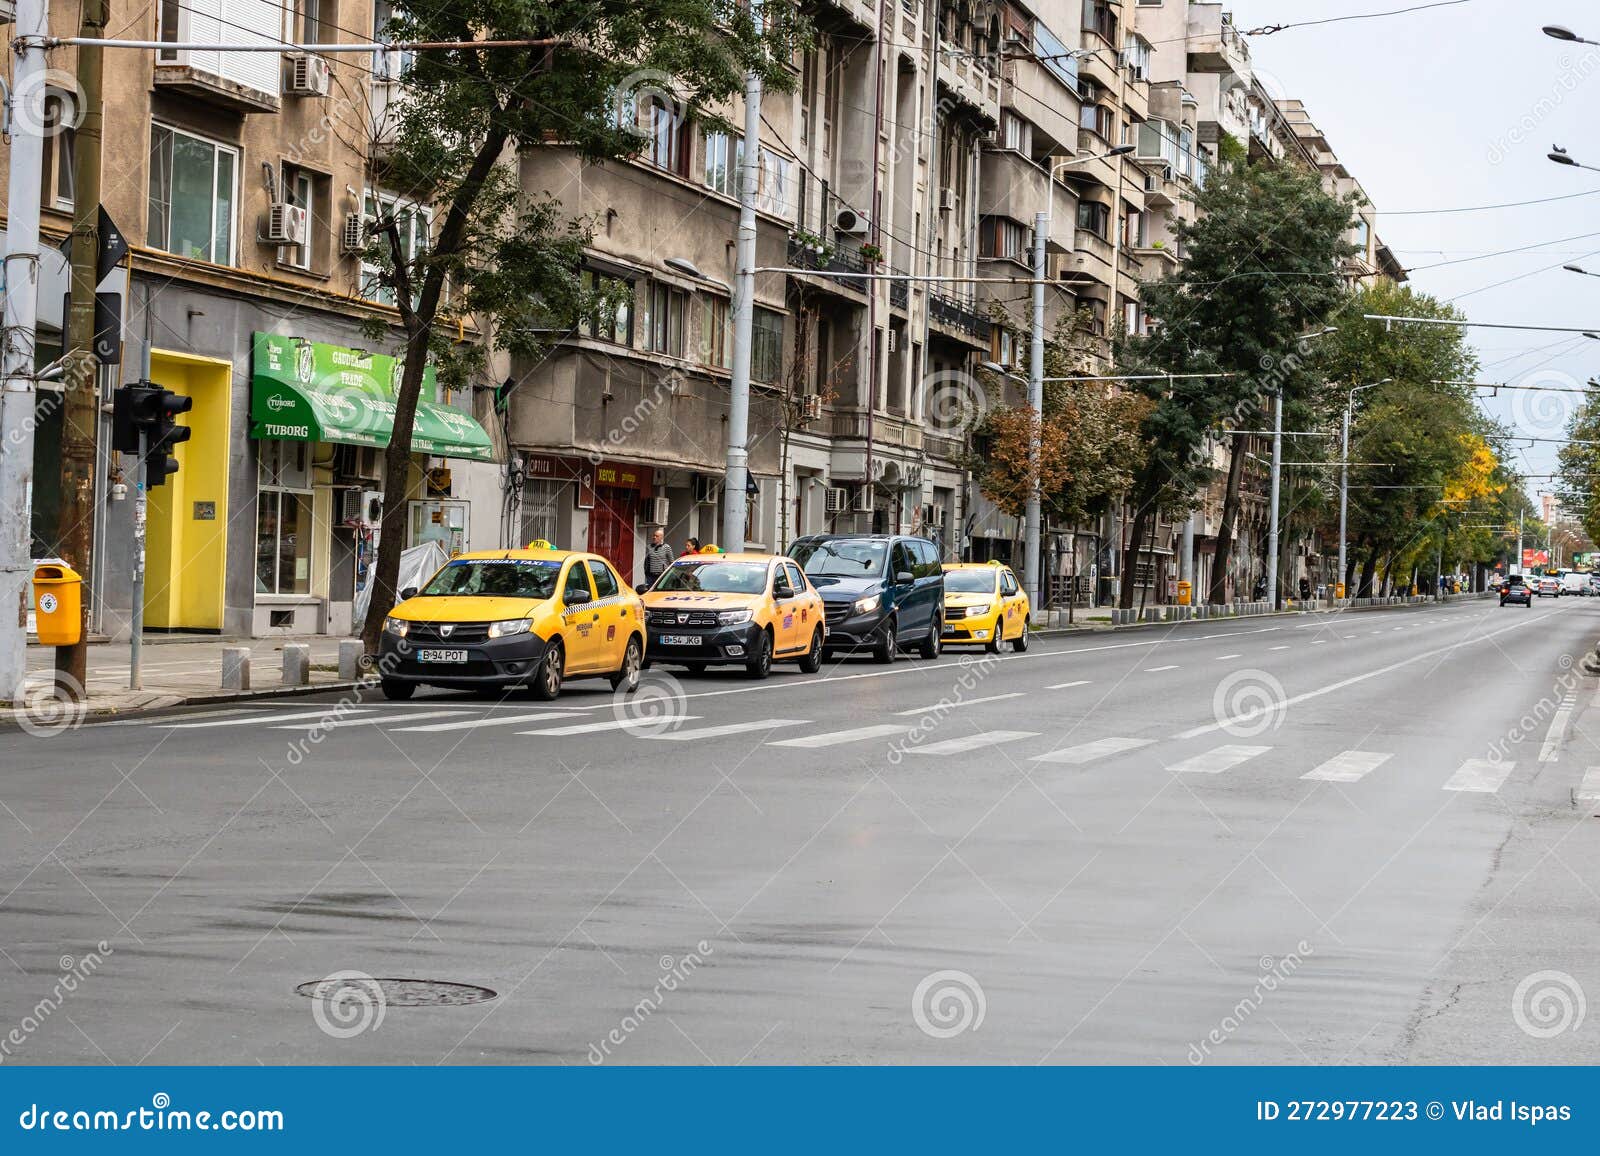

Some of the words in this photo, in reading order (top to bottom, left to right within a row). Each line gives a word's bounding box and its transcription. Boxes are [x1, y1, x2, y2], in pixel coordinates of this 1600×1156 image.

[341, 372, 363, 388] TRADE
[270, 399, 296, 409] TUBORG
[265, 423, 308, 438] TUBORG
[532, 540, 545, 549] TAXI
[672, 636, 682, 644] 54
[685, 636, 700, 645] JKG
[423, 650, 430, 660] B
[432, 650, 443, 660] 94
[445, 650, 464, 661] POT
